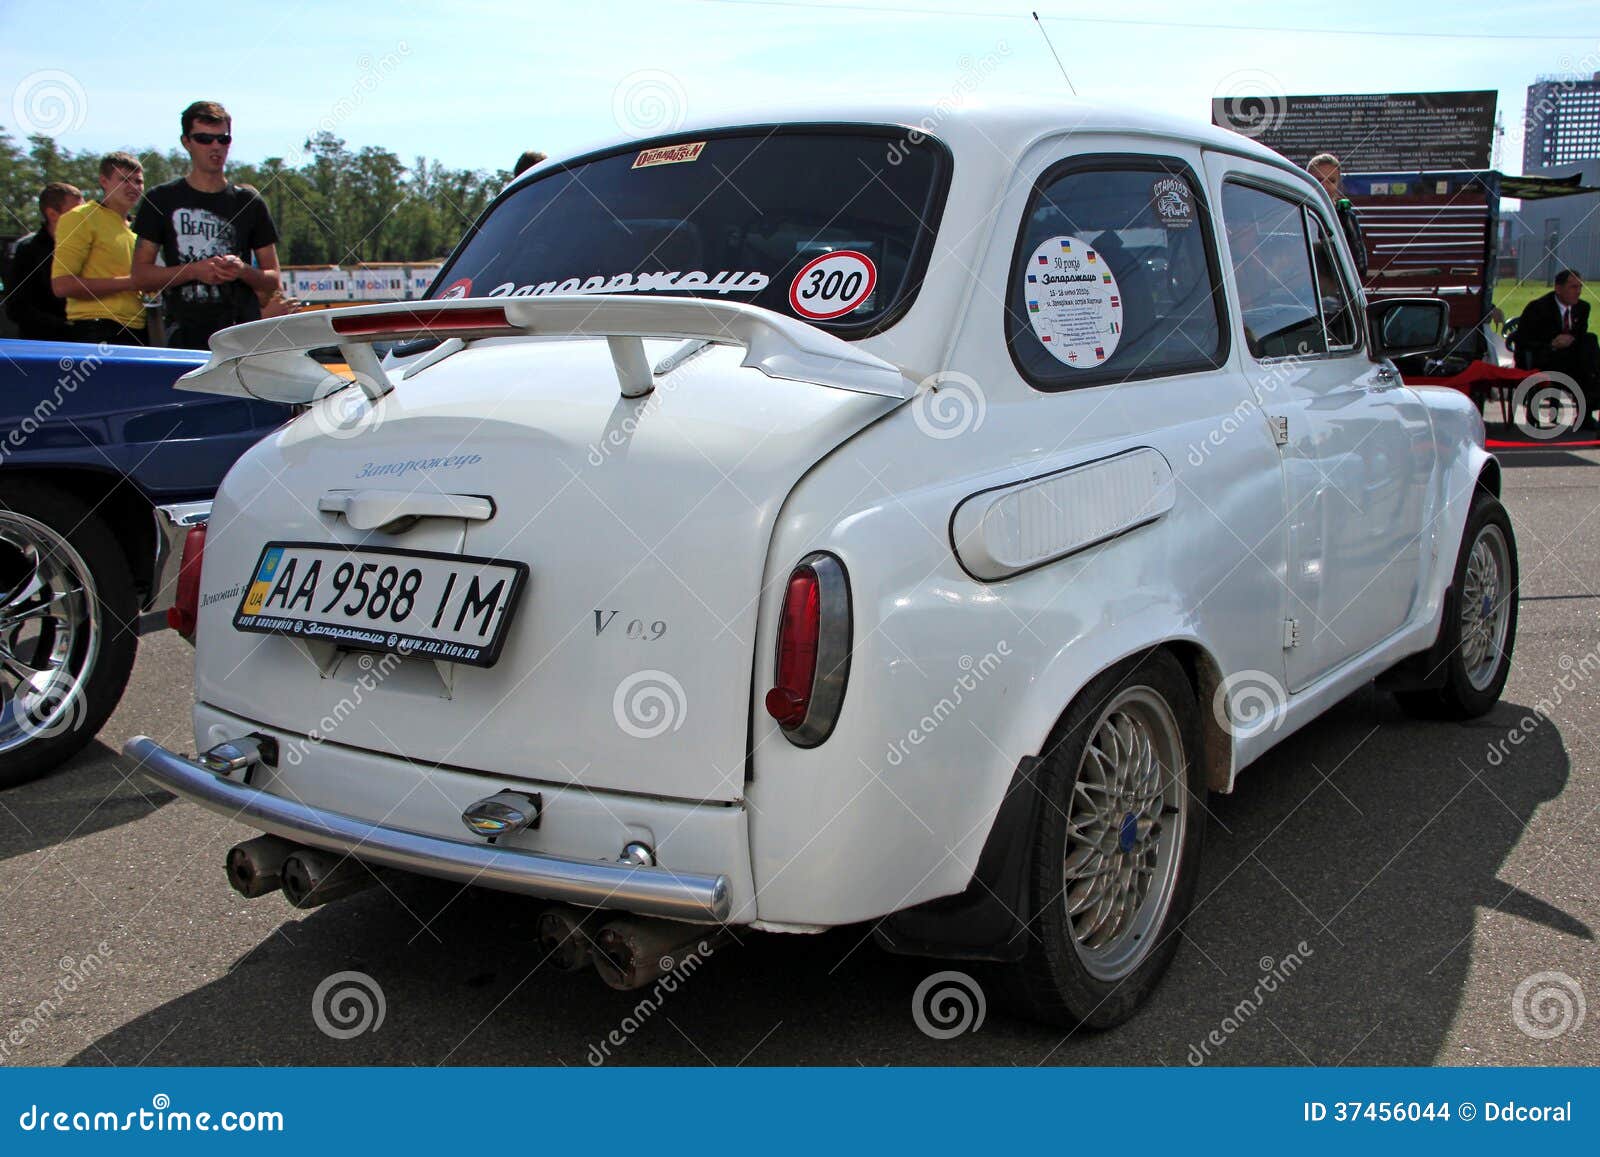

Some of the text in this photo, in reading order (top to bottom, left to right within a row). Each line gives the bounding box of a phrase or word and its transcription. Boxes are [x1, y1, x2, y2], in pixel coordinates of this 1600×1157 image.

[299, 280, 331, 292] Mobil
[356, 279, 388, 290] Mobil
[802, 268, 863, 302] 300
[249, 592, 264, 606] UA
[265, 557, 506, 637] AA 9588 IM
[593, 609, 620, 637] V
[398, 637, 480, 660] www.zaz.kiev.ua
